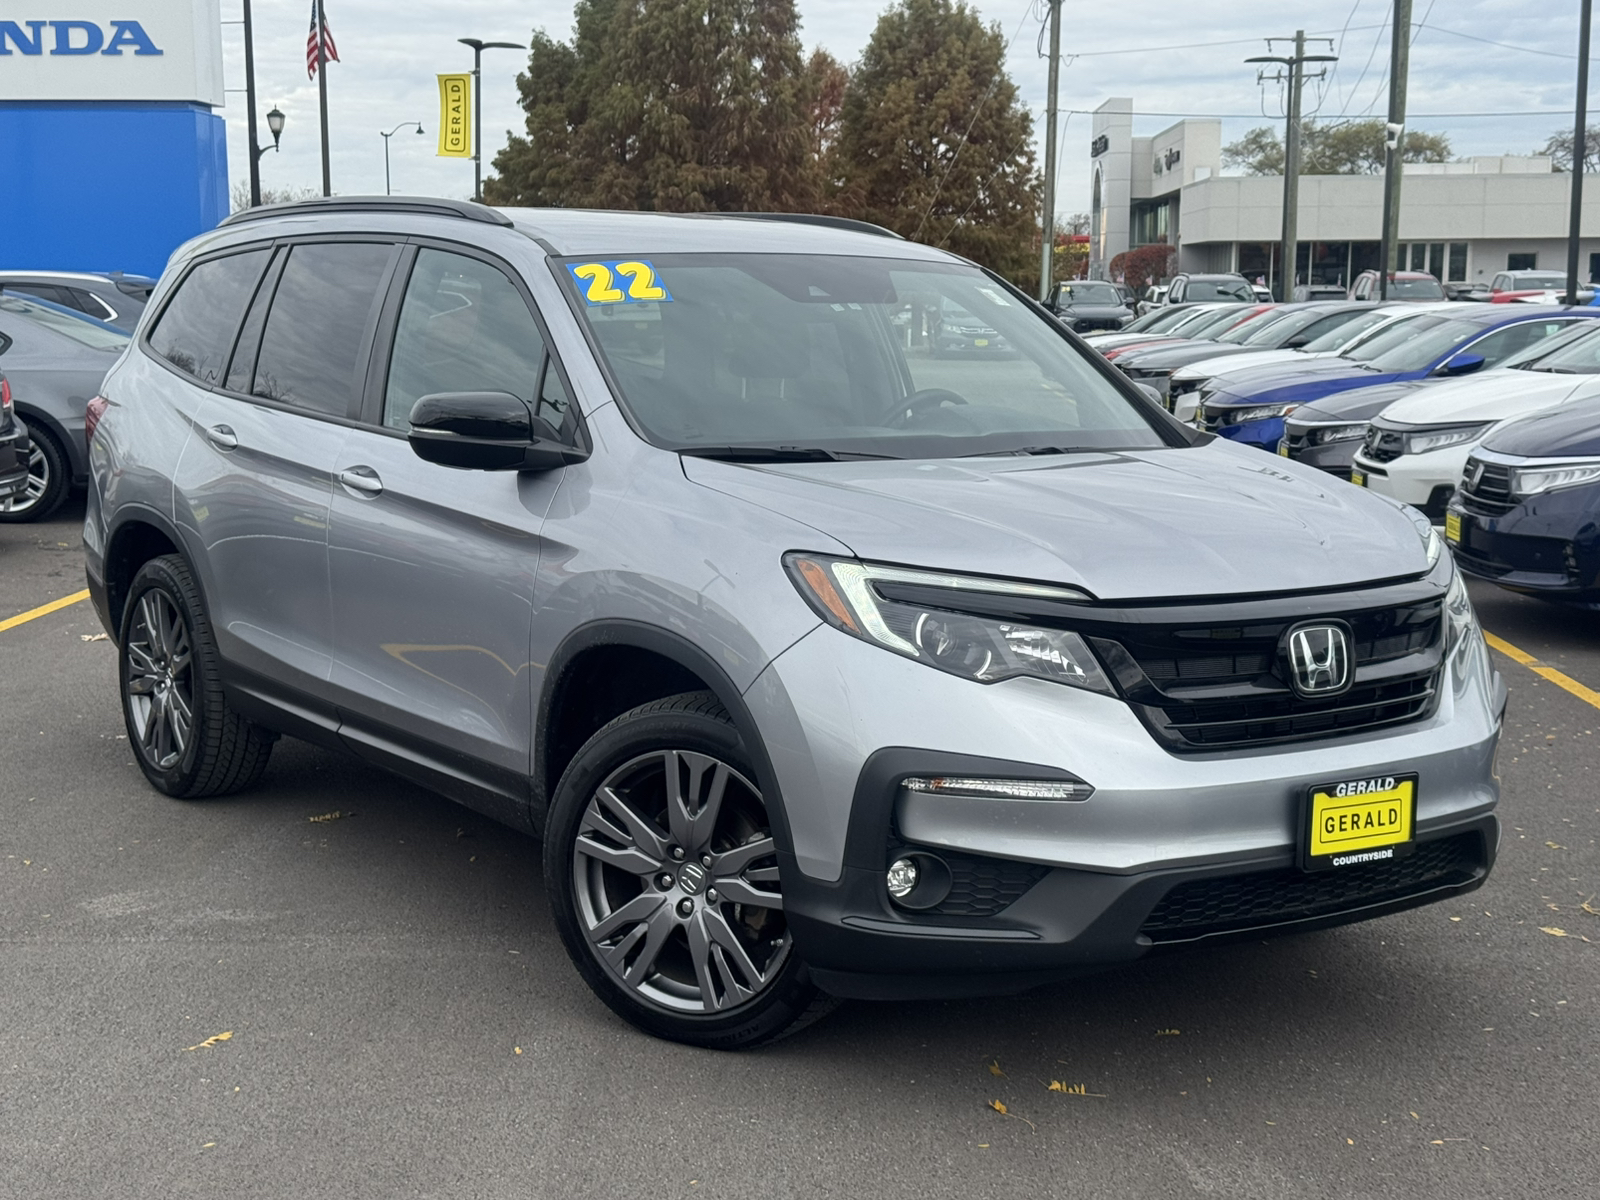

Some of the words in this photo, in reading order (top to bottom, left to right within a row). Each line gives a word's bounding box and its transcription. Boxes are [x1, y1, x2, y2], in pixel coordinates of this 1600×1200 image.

[0, 20, 164, 56] NDA
[450, 84, 461, 146] GERALD
[573, 262, 666, 302] 22
[1336, 777, 1395, 798] GERALD
[1324, 808, 1398, 834] GERALD
[1332, 849, 1394, 866] COUNTRYSIDE
